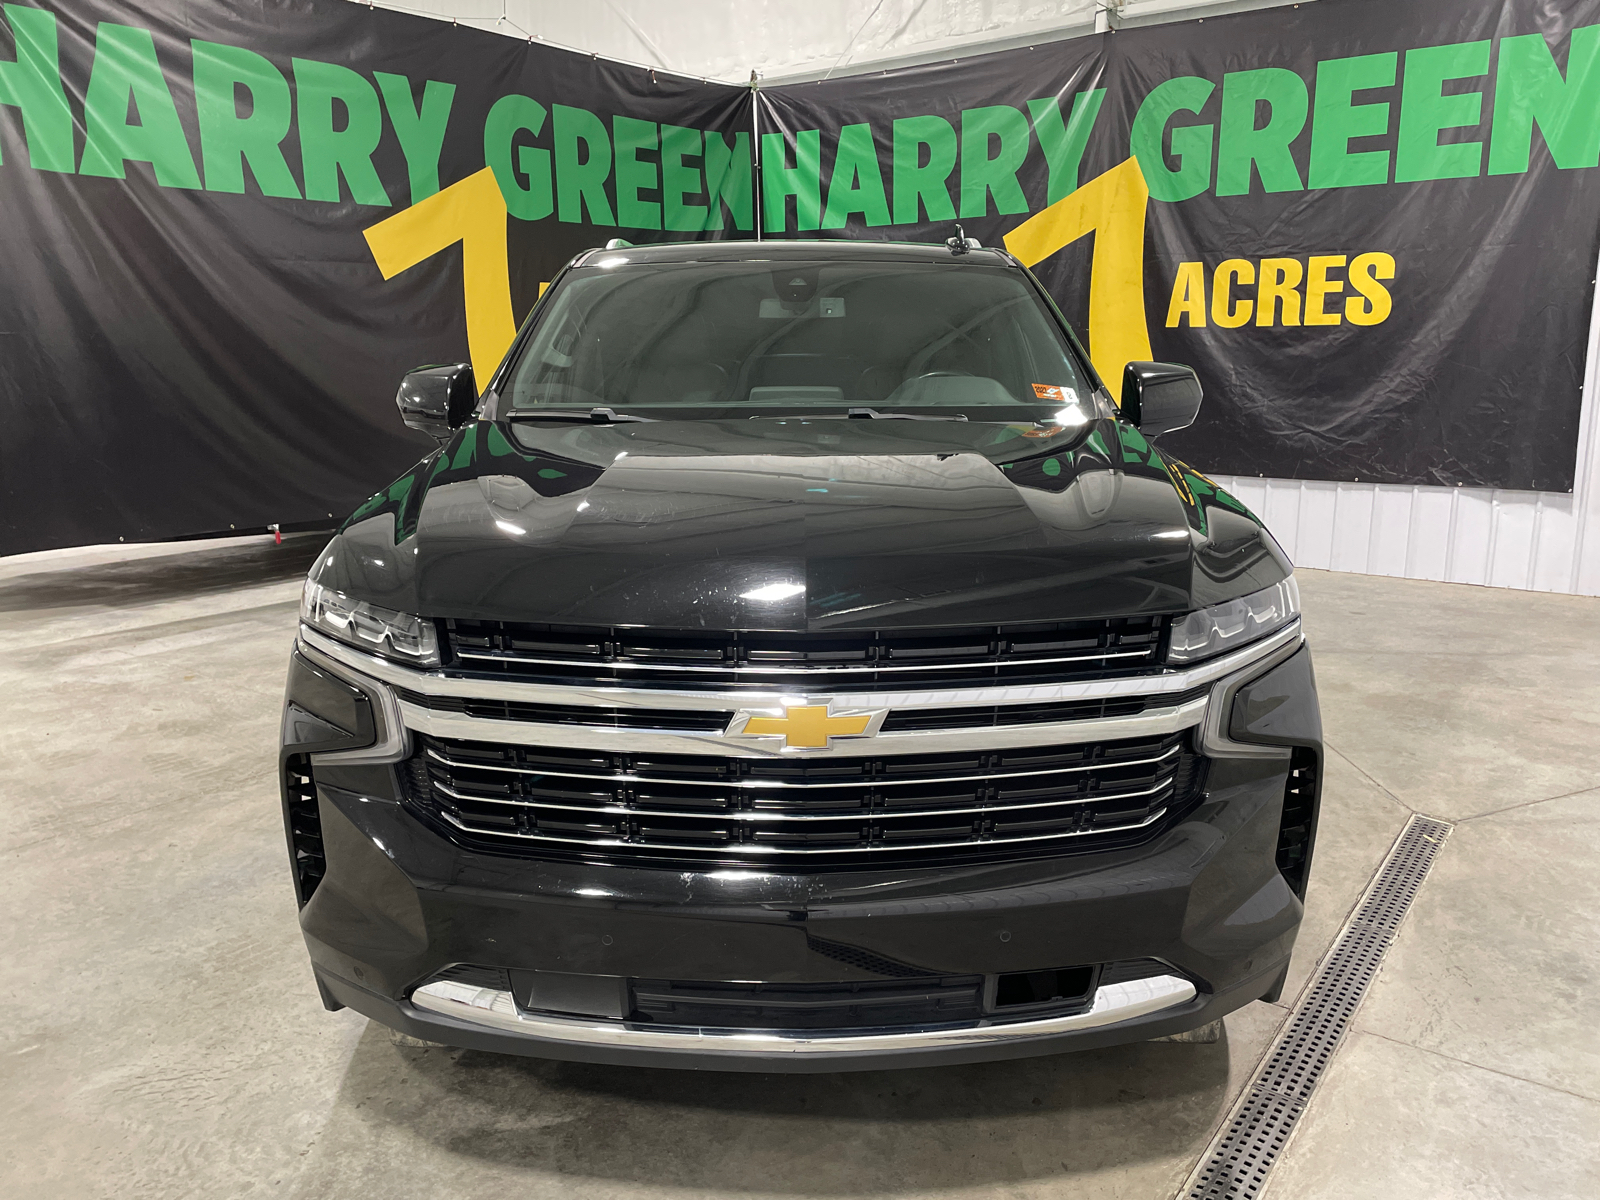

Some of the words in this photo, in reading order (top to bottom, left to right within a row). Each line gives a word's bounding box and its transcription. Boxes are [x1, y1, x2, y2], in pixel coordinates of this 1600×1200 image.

[0, 3, 456, 207] HARRY
[484, 94, 753, 232] GREEN
[762, 88, 1106, 233] HARRY
[1130, 24, 1600, 202] GREEN
[1003, 155, 1153, 408] 7
[1165, 252, 1395, 328] ACRES
